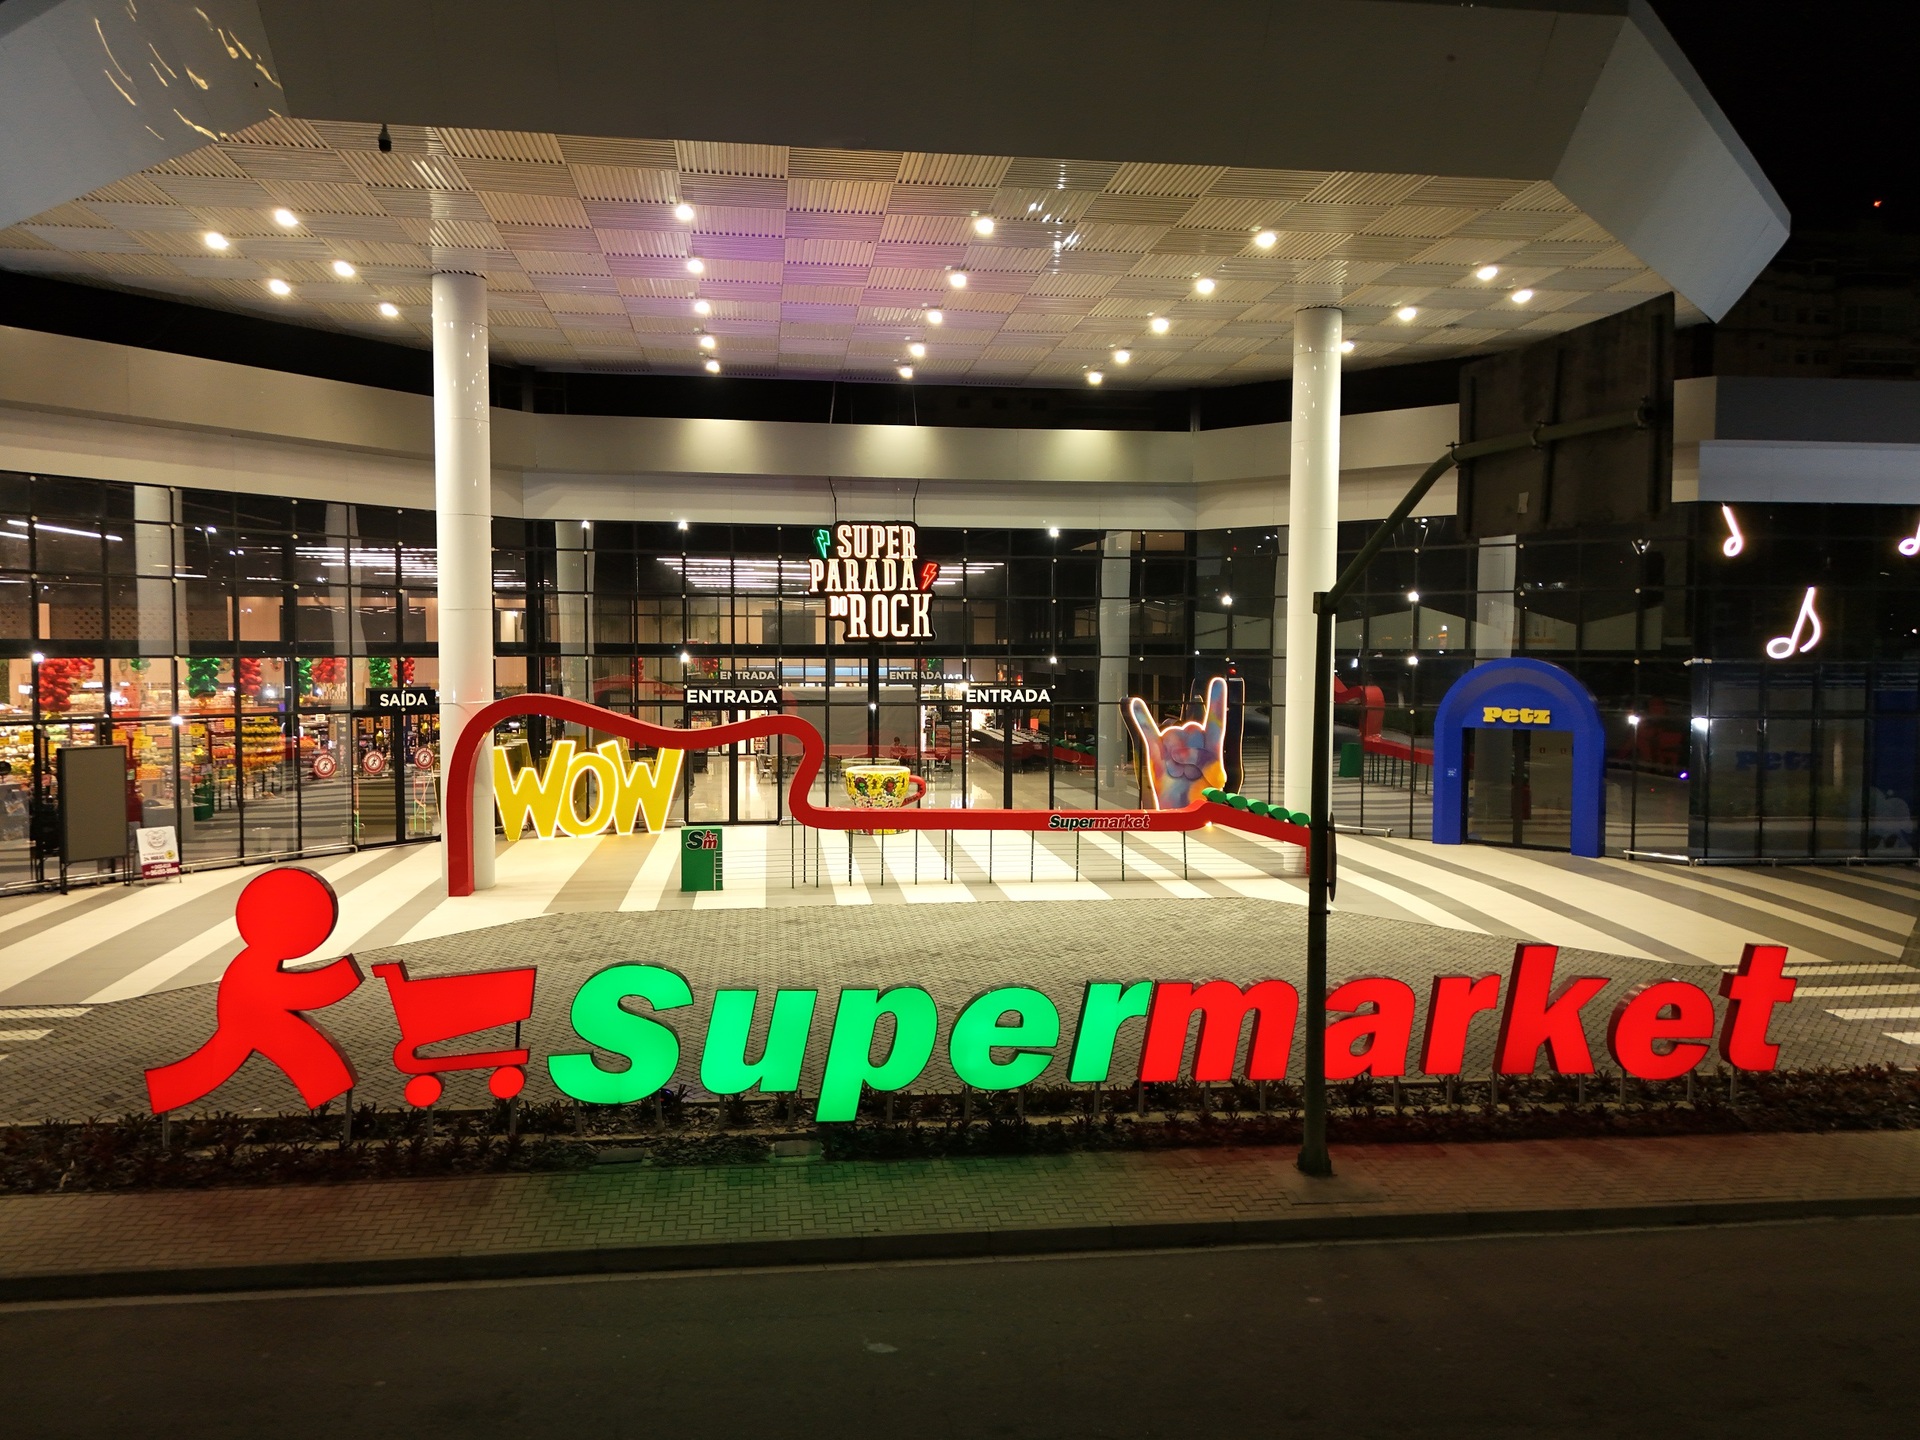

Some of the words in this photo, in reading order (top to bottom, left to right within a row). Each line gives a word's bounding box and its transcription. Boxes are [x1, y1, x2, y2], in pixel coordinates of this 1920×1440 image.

[837, 524, 918, 559] SUPER
[809, 558, 918, 592] PARADA
[829, 595, 848, 617] DO
[847, 593, 933, 638] ROCK
[720, 671, 775, 680] ENTRADA
[889, 671, 942, 680] ENTRADA
[379, 690, 428, 707] SAÍDA
[686, 689, 778, 704] ENTRADA
[966, 688, 1051, 703] ENTRADA
[1482, 706, 1551, 724] Petz
[493, 740, 685, 842] WOW
[1048, 814, 1150, 831] Supermarket
[547, 942, 1798, 1123] Supermarket
